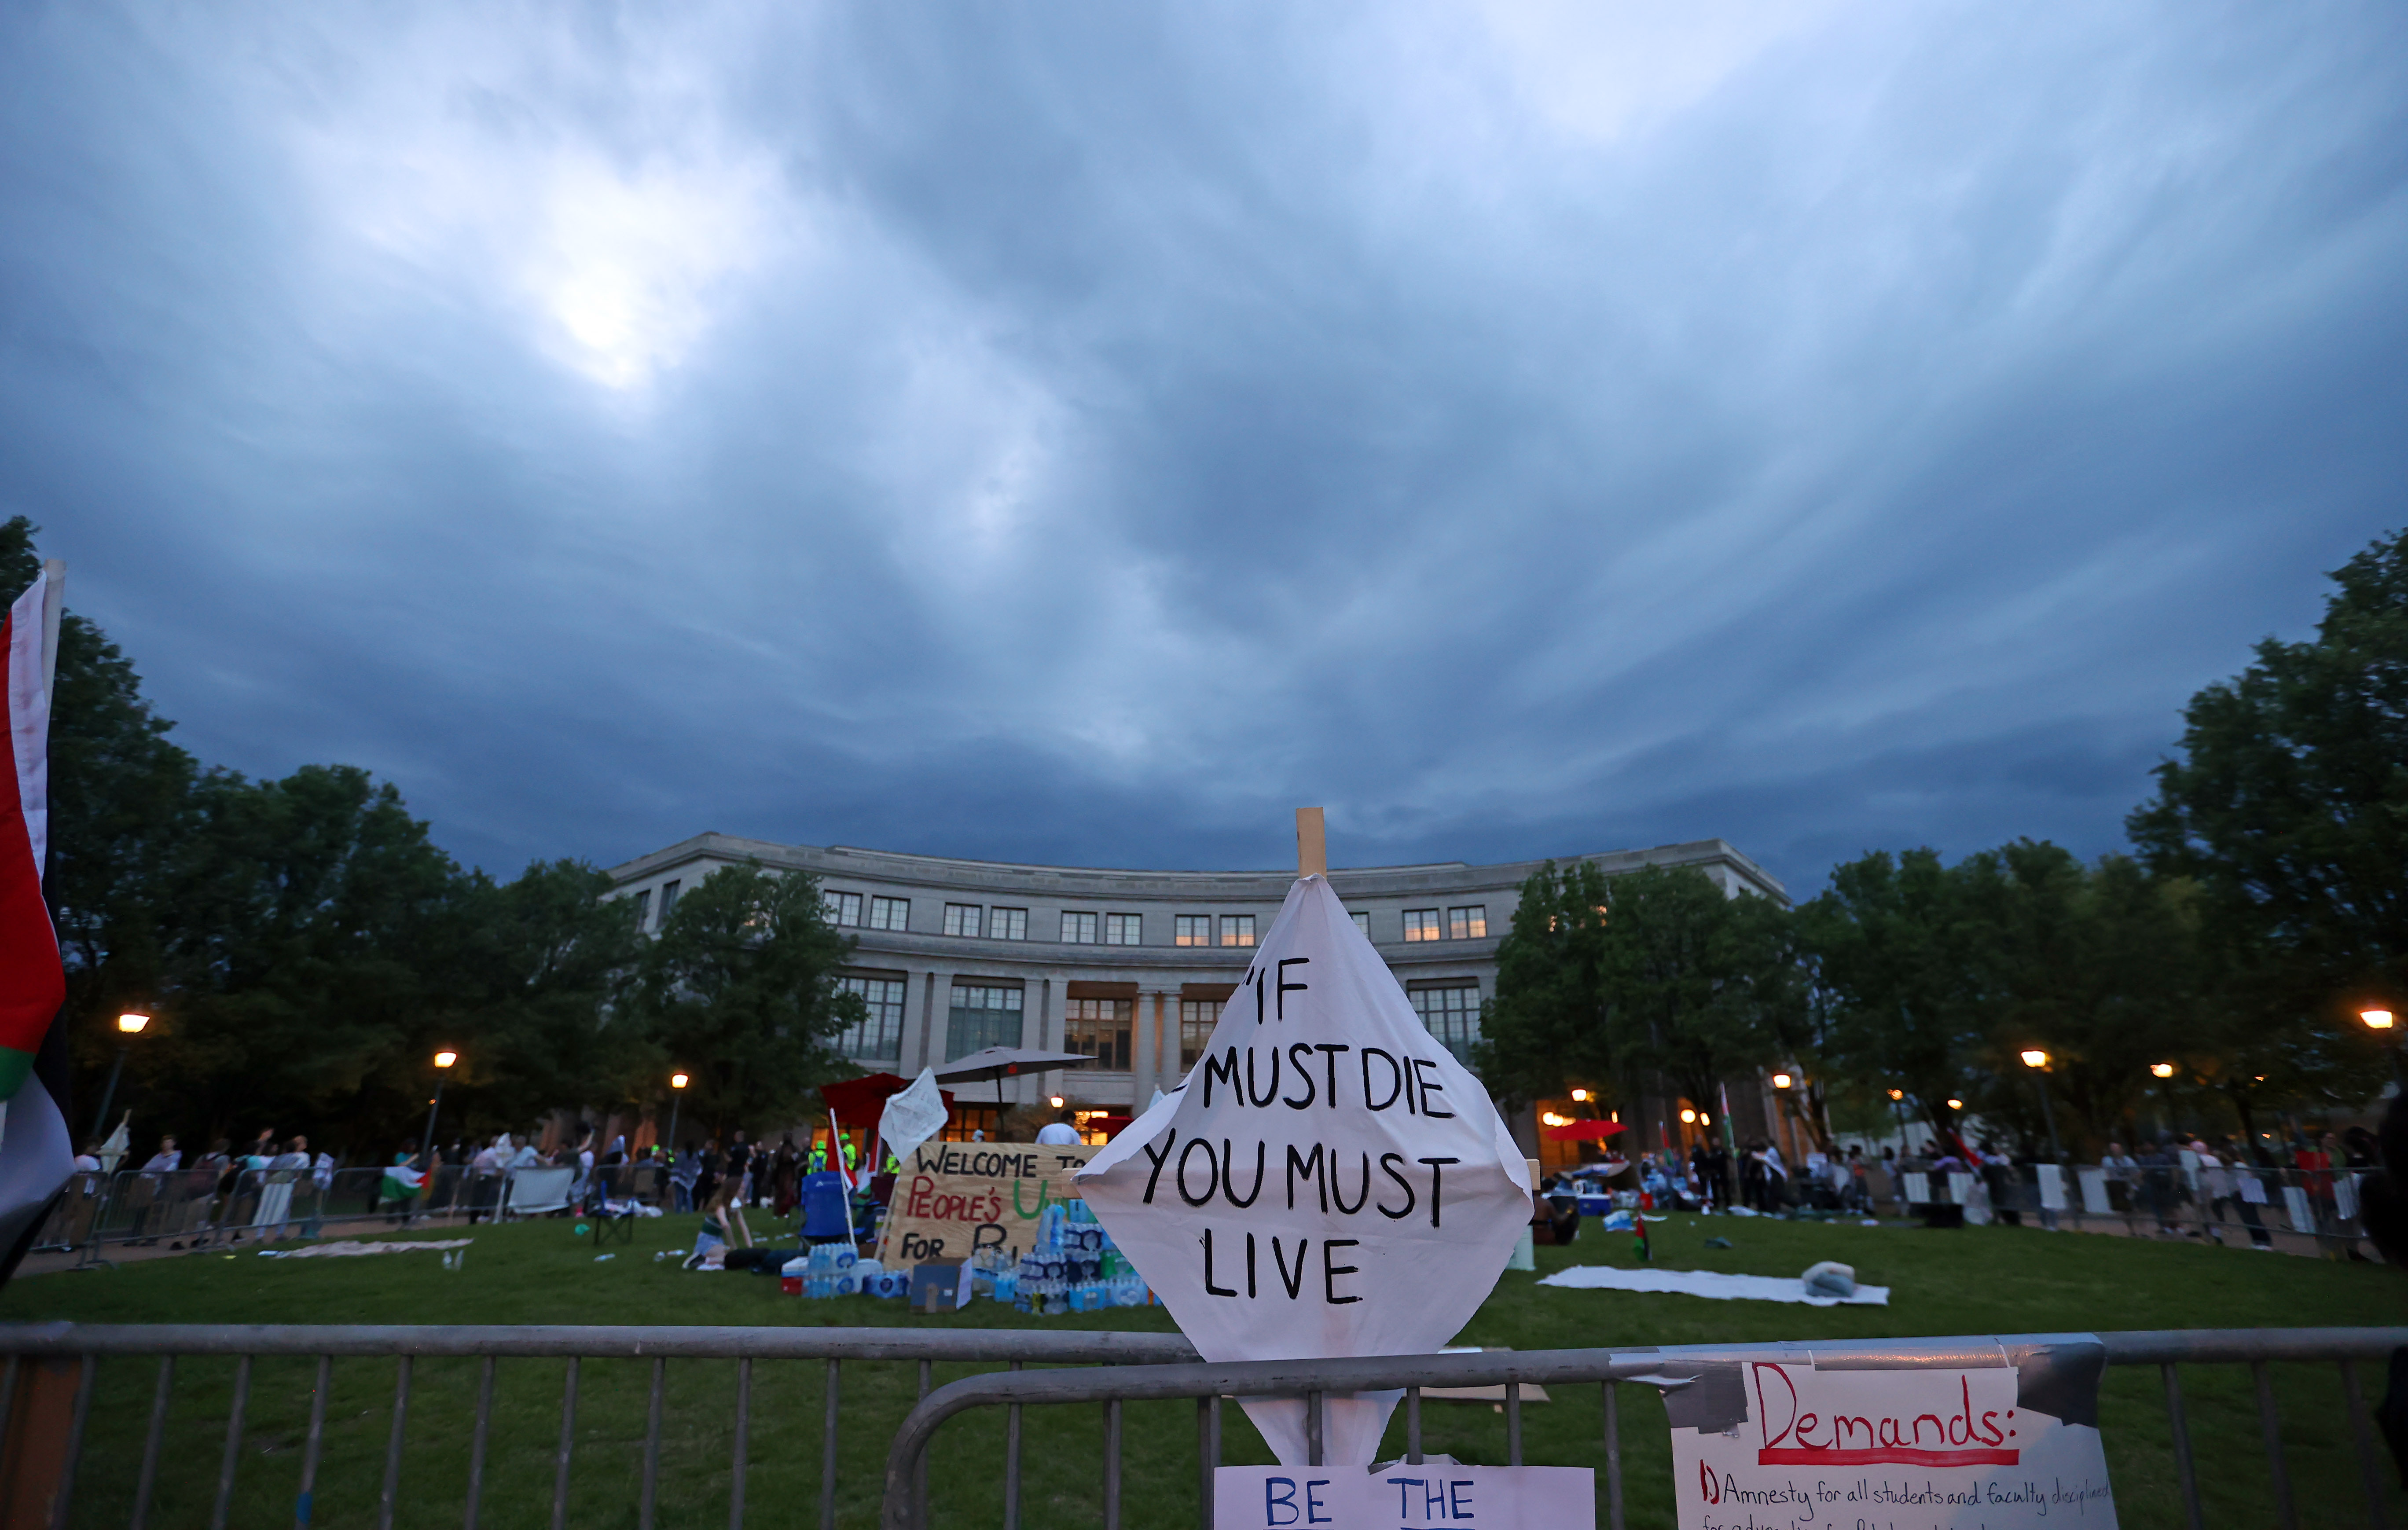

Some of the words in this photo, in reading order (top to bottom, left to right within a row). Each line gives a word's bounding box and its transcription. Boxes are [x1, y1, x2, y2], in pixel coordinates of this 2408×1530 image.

[1204, 1043, 1349, 1109] MUST
[1361, 1048, 1456, 1118] DIE
[916, 1144, 1037, 1178] WELCOME
[1143, 1128, 1265, 1208] YOU
[1287, 1142, 1461, 1229] MUST
[907, 1176, 1002, 1223] PEOPLE'S
[901, 1233, 944, 1259] FOR
[1204, 1229, 1363, 1304] LIVE
[1751, 1362, 2017, 1449] Demands:
[1266, 1477, 1332, 1526] BE
[1388, 1478, 1474, 1519] THE
[1723, 1473, 1814, 1522] Amnesty
[1817, 1481, 1842, 1501] for
[1847, 1479, 1868, 1502] all
[1874, 1481, 1943, 1505] students
[1948, 1481, 1981, 1506] and
[1987, 1482, 2047, 1515] faculty
[2052, 1476, 2111, 1515] disciplined
